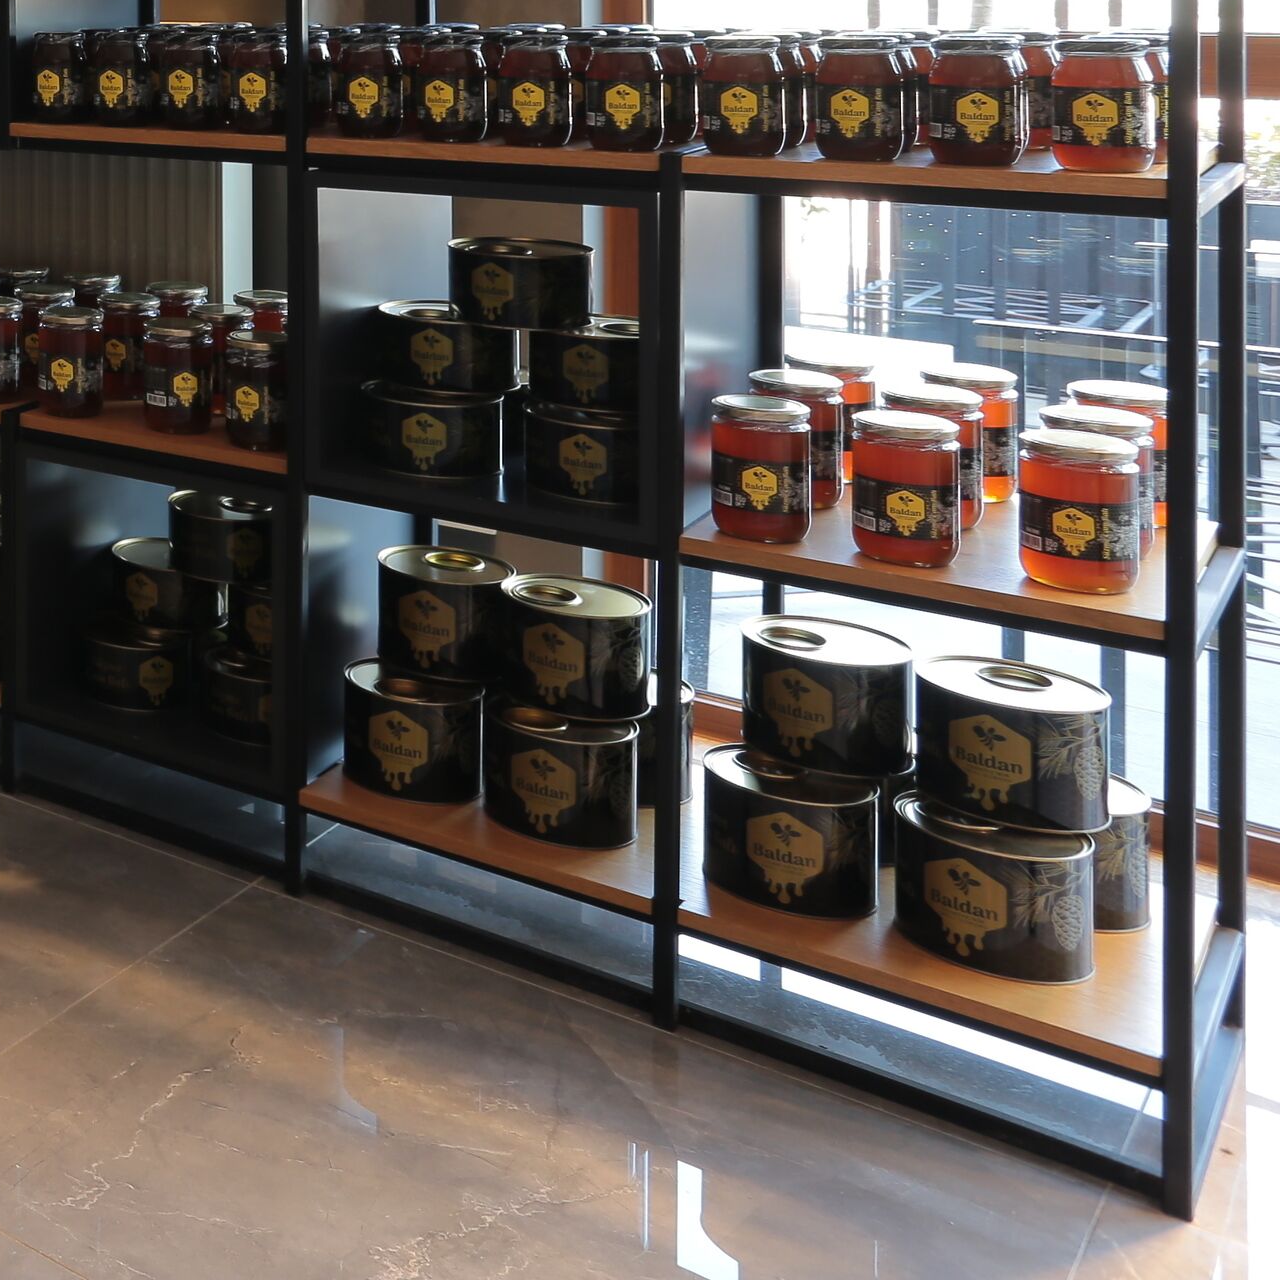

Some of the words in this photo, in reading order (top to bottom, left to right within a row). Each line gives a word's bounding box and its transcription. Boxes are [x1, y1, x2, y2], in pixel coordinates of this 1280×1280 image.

[240, 87, 264, 95] Baldan
[427, 96, 452, 104] Baldan
[515, 99, 542, 108] Baldan
[607, 101, 638, 110] Baldan
[723, 105, 755, 113] Baldan
[833, 108, 866, 117] Baldan
[959, 112, 996, 121] Baldan
[1075, 113, 1114, 123] Baldan
[405, 435, 443, 446] Baldan
[562, 457, 603, 468] Baldan
[744, 482, 775, 492] Baldan
[889, 506, 922, 517] Baldan
[1056, 525, 1092, 536] Baldan
[527, 651, 578, 672] Baldan
[767, 697, 828, 725] Baldan
[372, 738, 423, 760] Baldan
[955, 746, 1025, 776] Baldan
[515, 777, 570, 801] Baldan
[752, 843, 818, 869] Baldan
[929, 889, 1000, 923] Baldan
